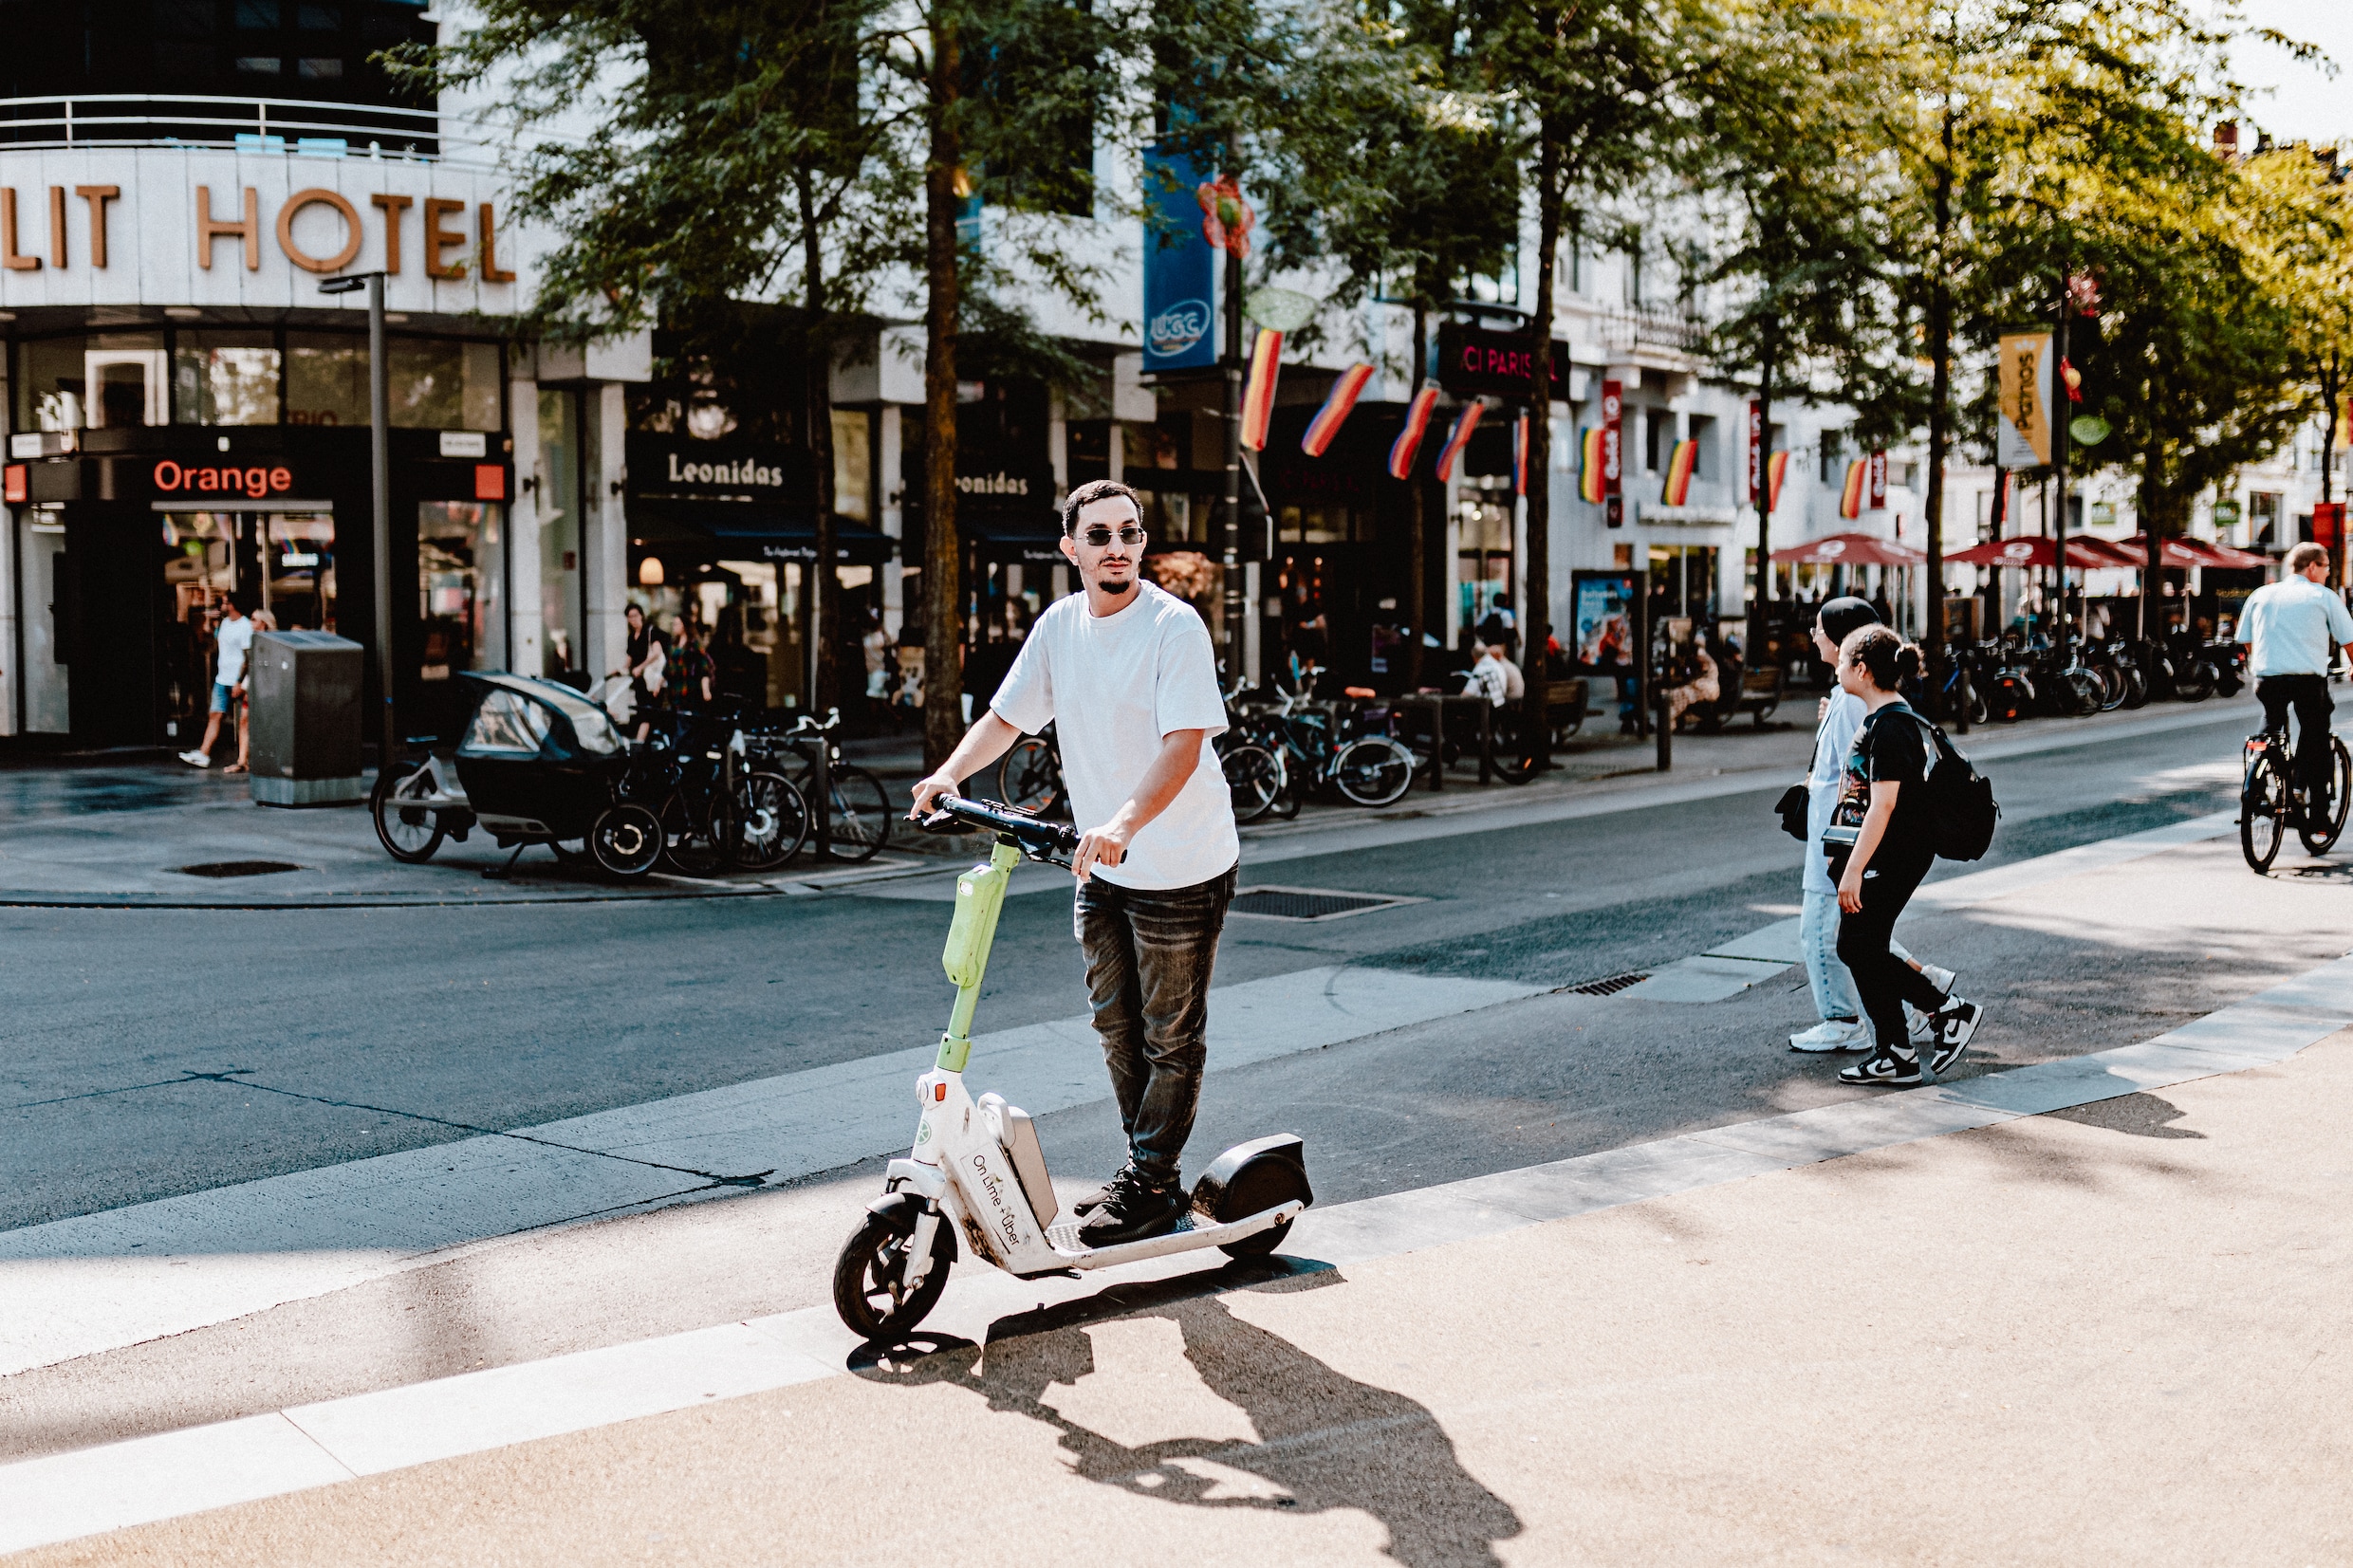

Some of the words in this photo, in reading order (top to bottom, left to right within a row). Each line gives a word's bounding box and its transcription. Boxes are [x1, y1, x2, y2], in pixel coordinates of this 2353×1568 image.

[0, 185, 120, 271] LIT
[196, 185, 516, 282] HOTEL
[1151, 312, 1200, 341] UGC
[2015, 350, 2034, 432] Panos
[669, 452, 784, 487] Leonidas
[1604, 429, 1620, 480] Quick
[154, 460, 292, 498] Orange
[954, 470, 1028, 496] onidas
[973, 1154, 988, 1176] On
[982, 1176, 1002, 1207] Lime
[1001, 1213, 1020, 1245] Uber
